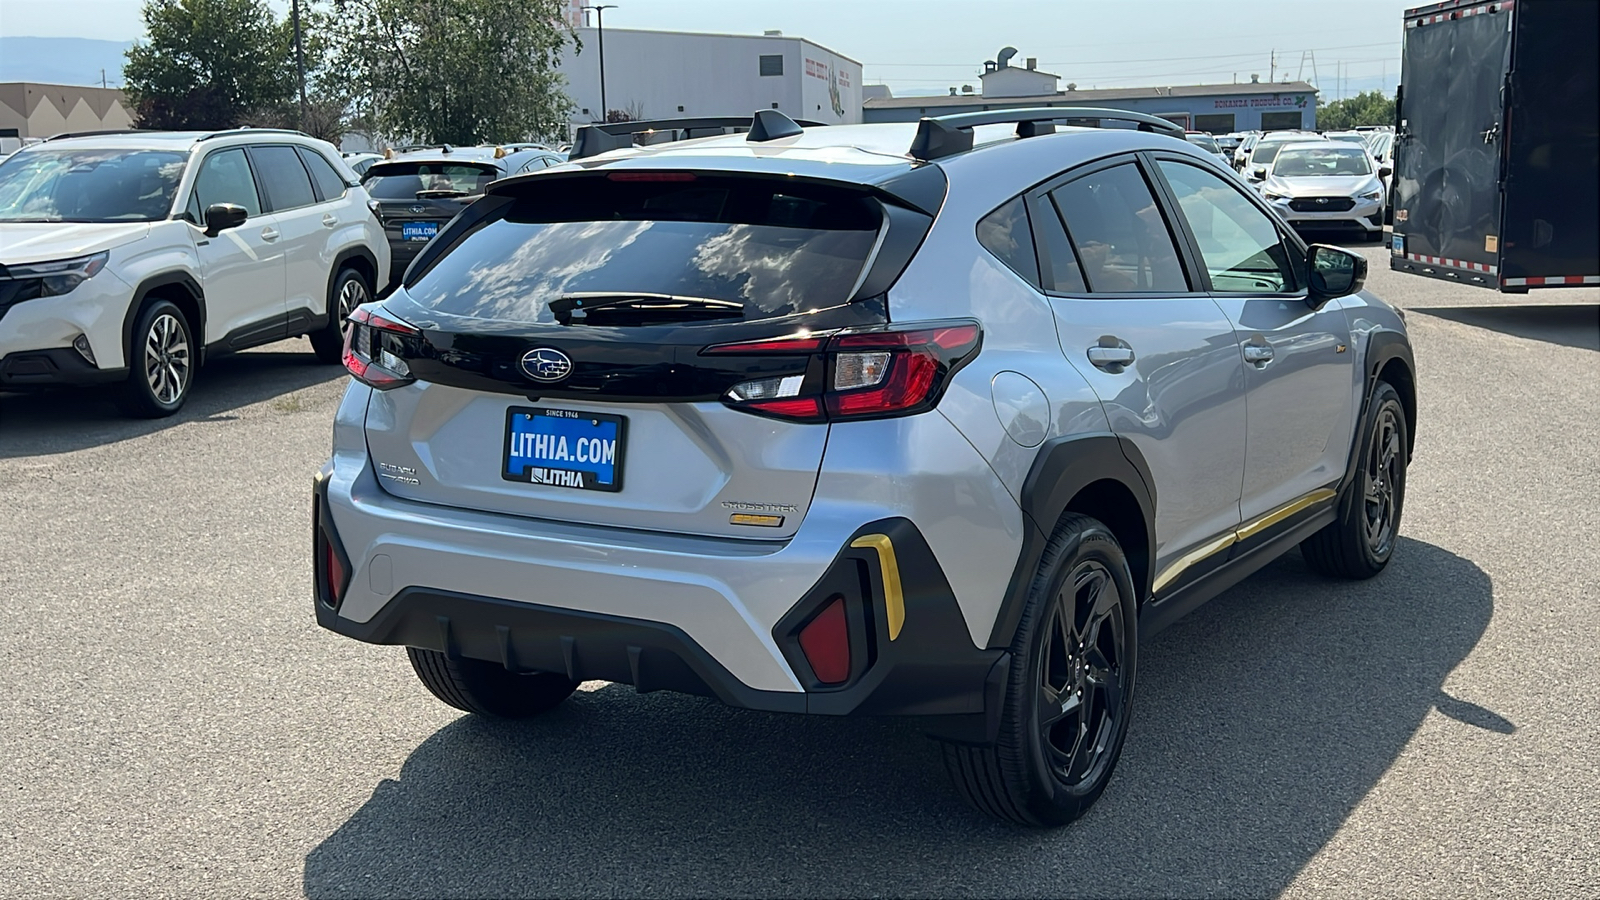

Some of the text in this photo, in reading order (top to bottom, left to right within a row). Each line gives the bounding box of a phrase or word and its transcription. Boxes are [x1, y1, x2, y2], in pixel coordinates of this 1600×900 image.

[1215, 99, 1248, 108] BONANZA
[1250, 98, 1281, 107] PRODUCE
[546, 409, 579, 419] SINCE 1946
[510, 431, 617, 466] LITHIA.COM
[380, 462, 416, 474] SUBARU
[542, 468, 585, 488] LITHIA
[721, 501, 799, 512] CROSSTREK
